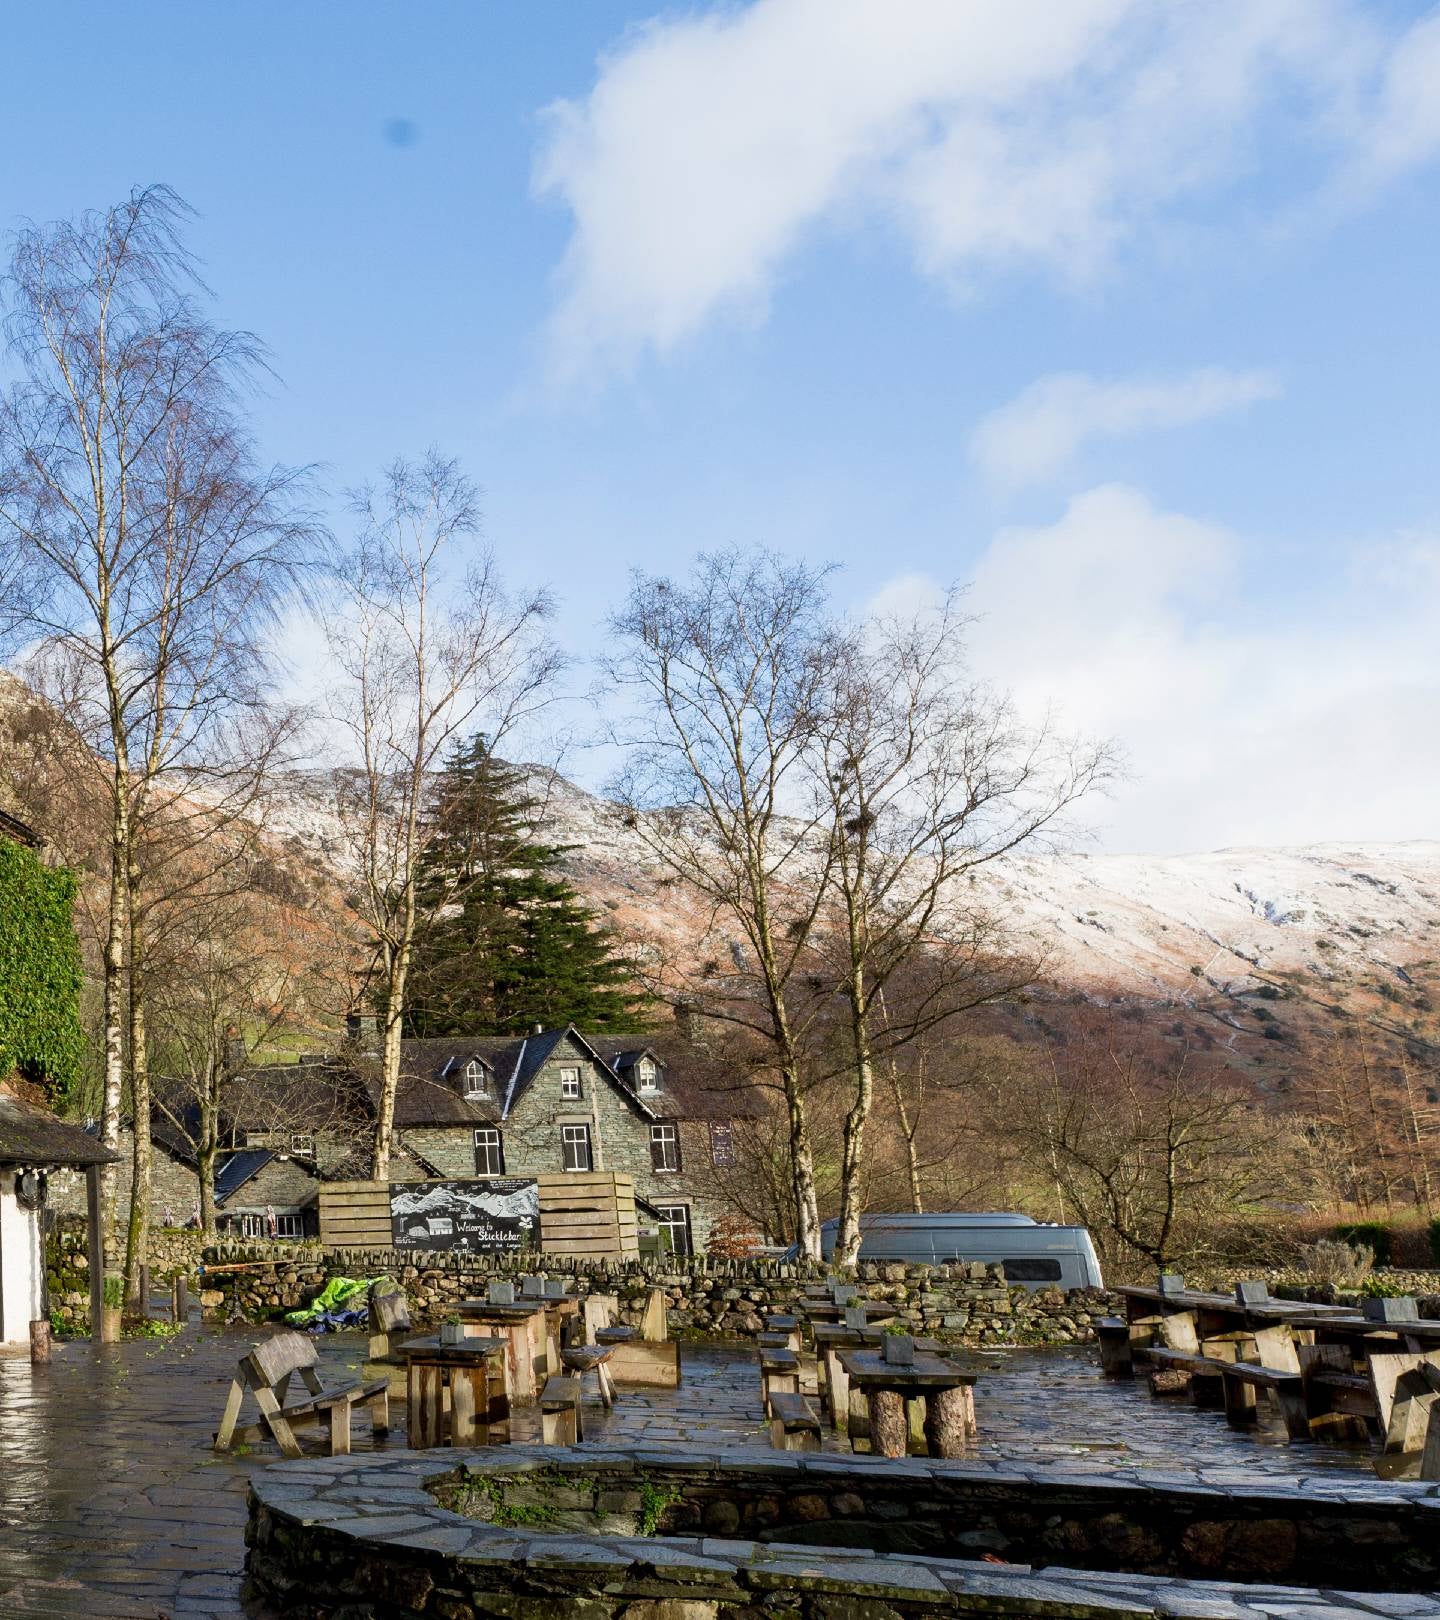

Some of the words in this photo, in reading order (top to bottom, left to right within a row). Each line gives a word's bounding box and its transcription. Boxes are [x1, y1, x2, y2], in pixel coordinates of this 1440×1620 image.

[456, 1221, 485, 1232] Welcome
[486, 1221, 493, 1231] to
[478, 1230, 522, 1241] Sticklebar
